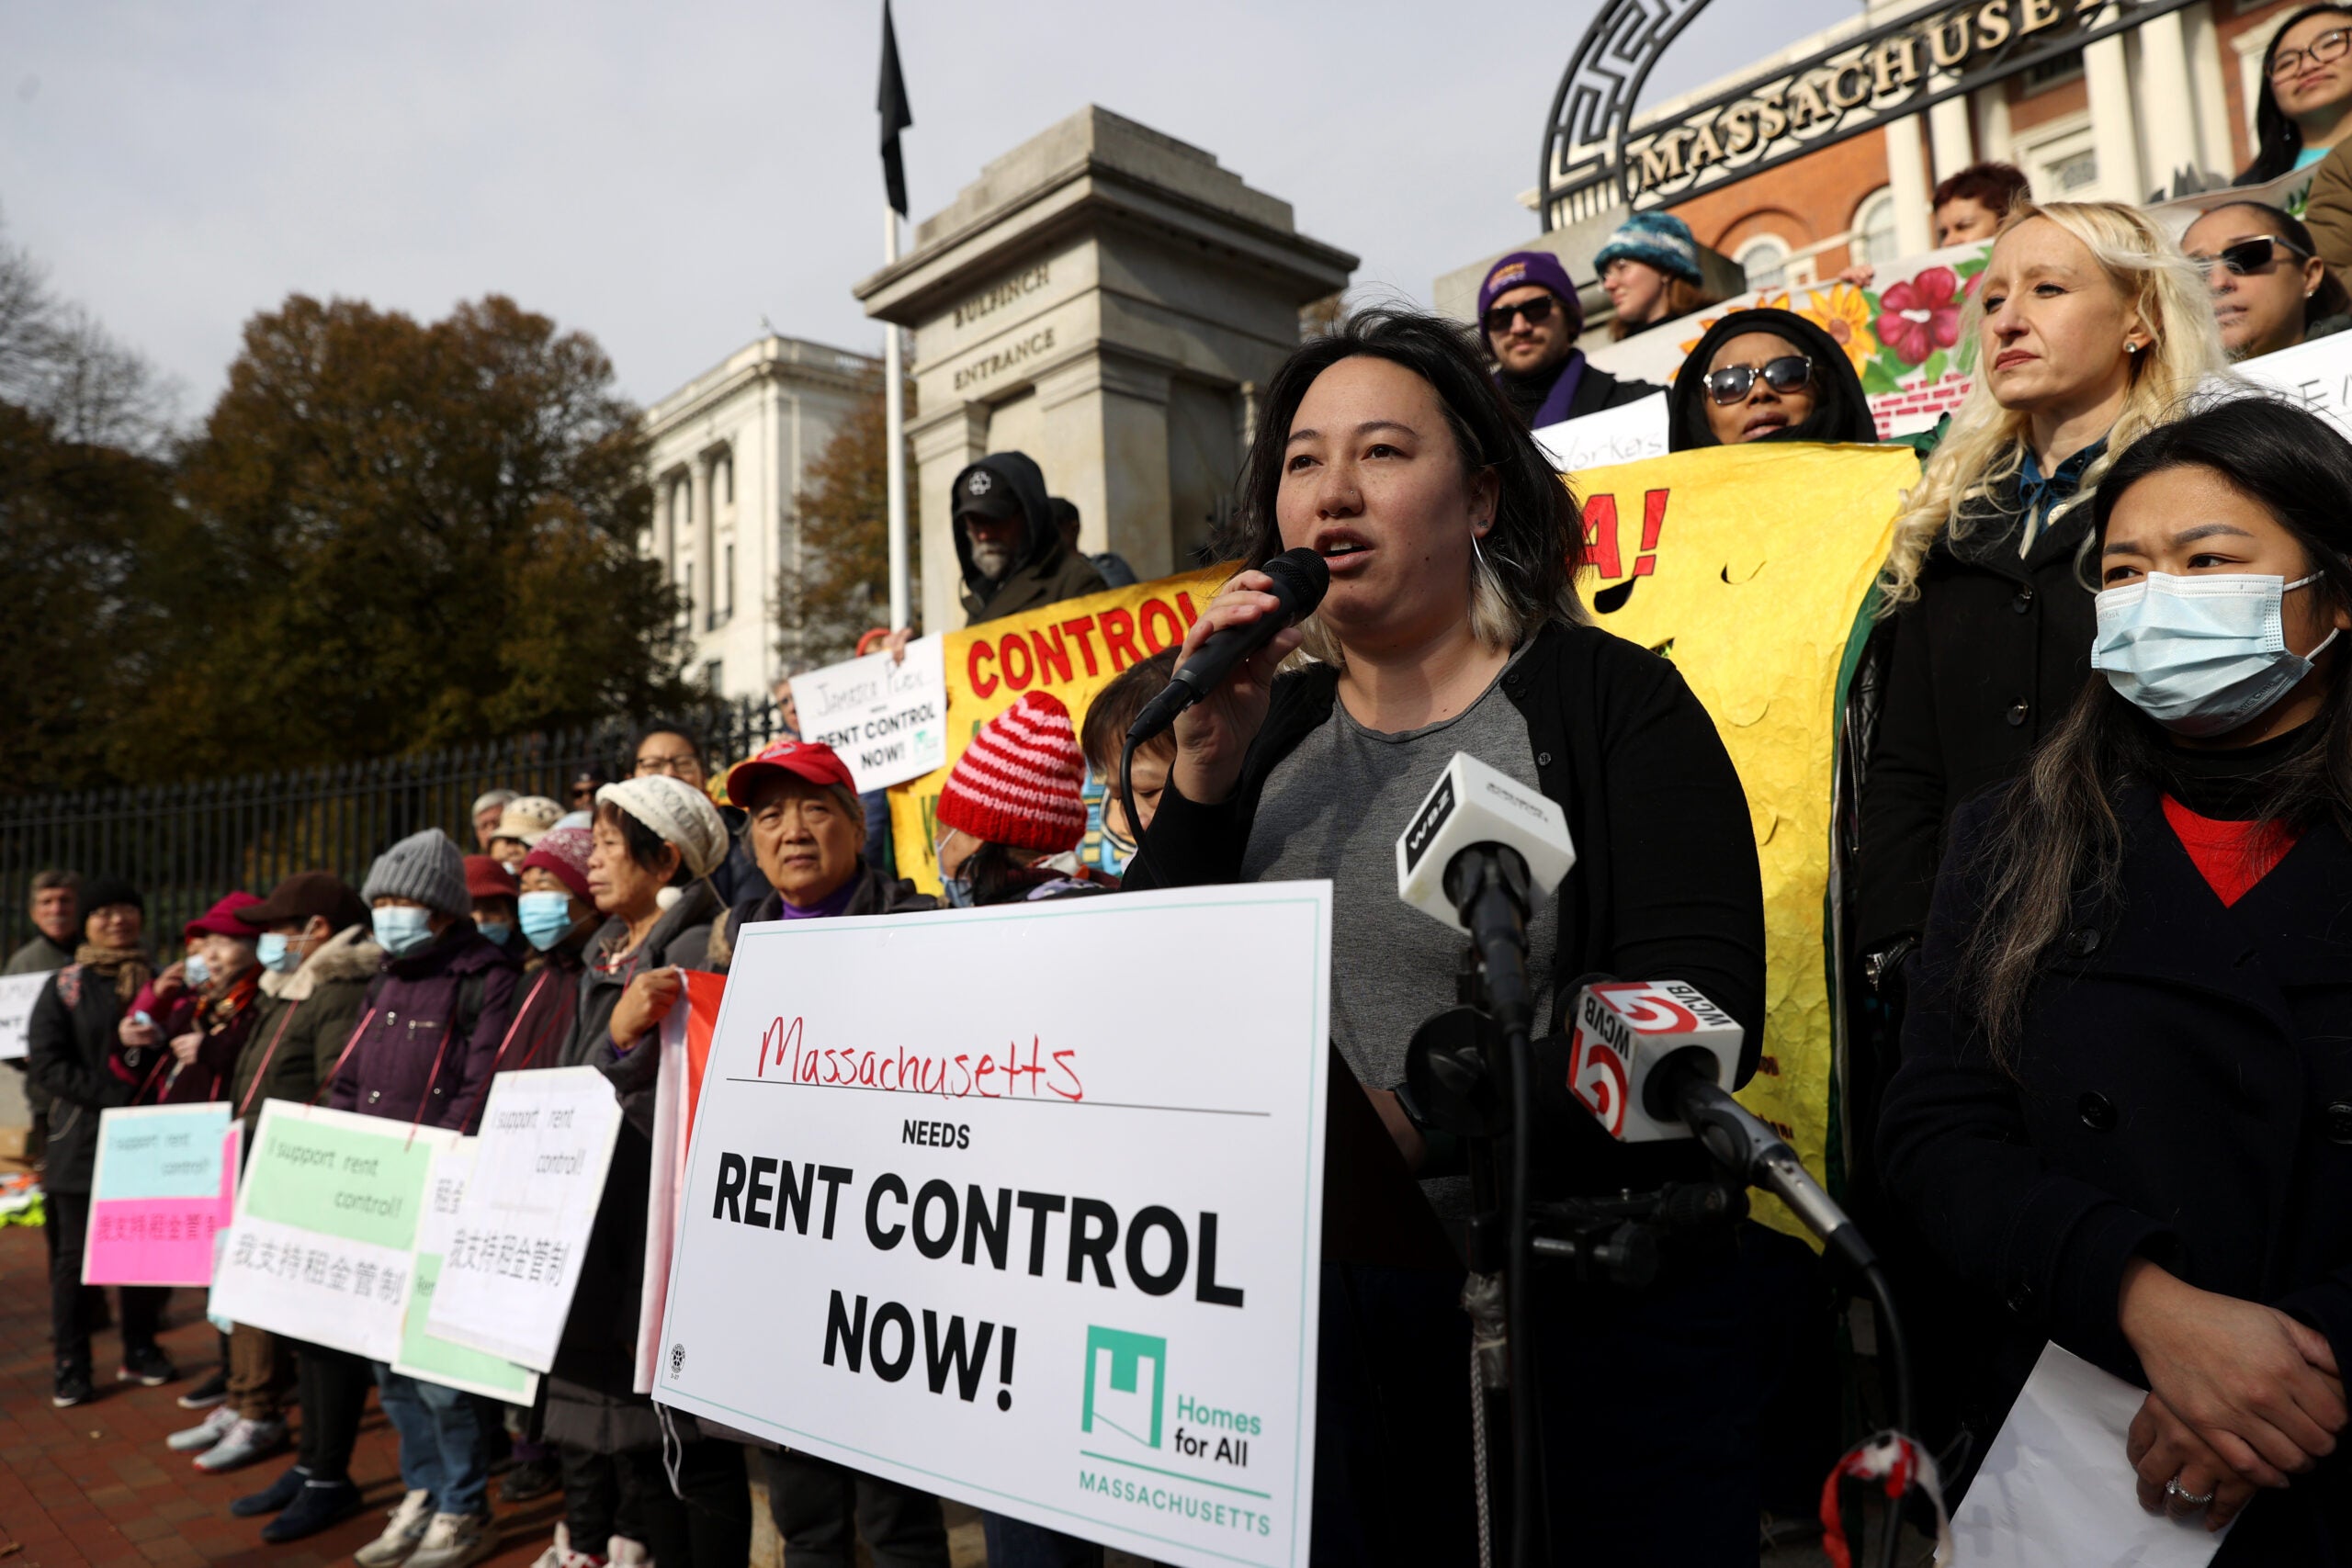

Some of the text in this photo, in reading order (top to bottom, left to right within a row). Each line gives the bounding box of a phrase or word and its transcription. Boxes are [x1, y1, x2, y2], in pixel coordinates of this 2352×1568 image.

[1640, 0, 2104, 188] MASSACHUSE
[955, 327, 1055, 390] ENTRANCE
[865, 702, 935, 739] CONTROL
[861, 740, 905, 771] NOW!
[1409, 789, 1450, 851] WBZ
[1585, 998, 1630, 1060] WCVB
[1667, 986, 1732, 1026] WCVB
[758, 1016, 1083, 1101] Massachusetts
[277, 1141, 336, 1168] support
[343, 1155, 379, 1177] rent
[902, 1119, 970, 1149] NEEDS
[712, 1151, 1244, 1308] RENT CONTROL
[822, 1289, 1017, 1413] NOW!
[1177, 1393, 1261, 1436] Homes
[1174, 1427, 1248, 1467] for All
[1080, 1471, 1271, 1536] MASSACHUSETTS
